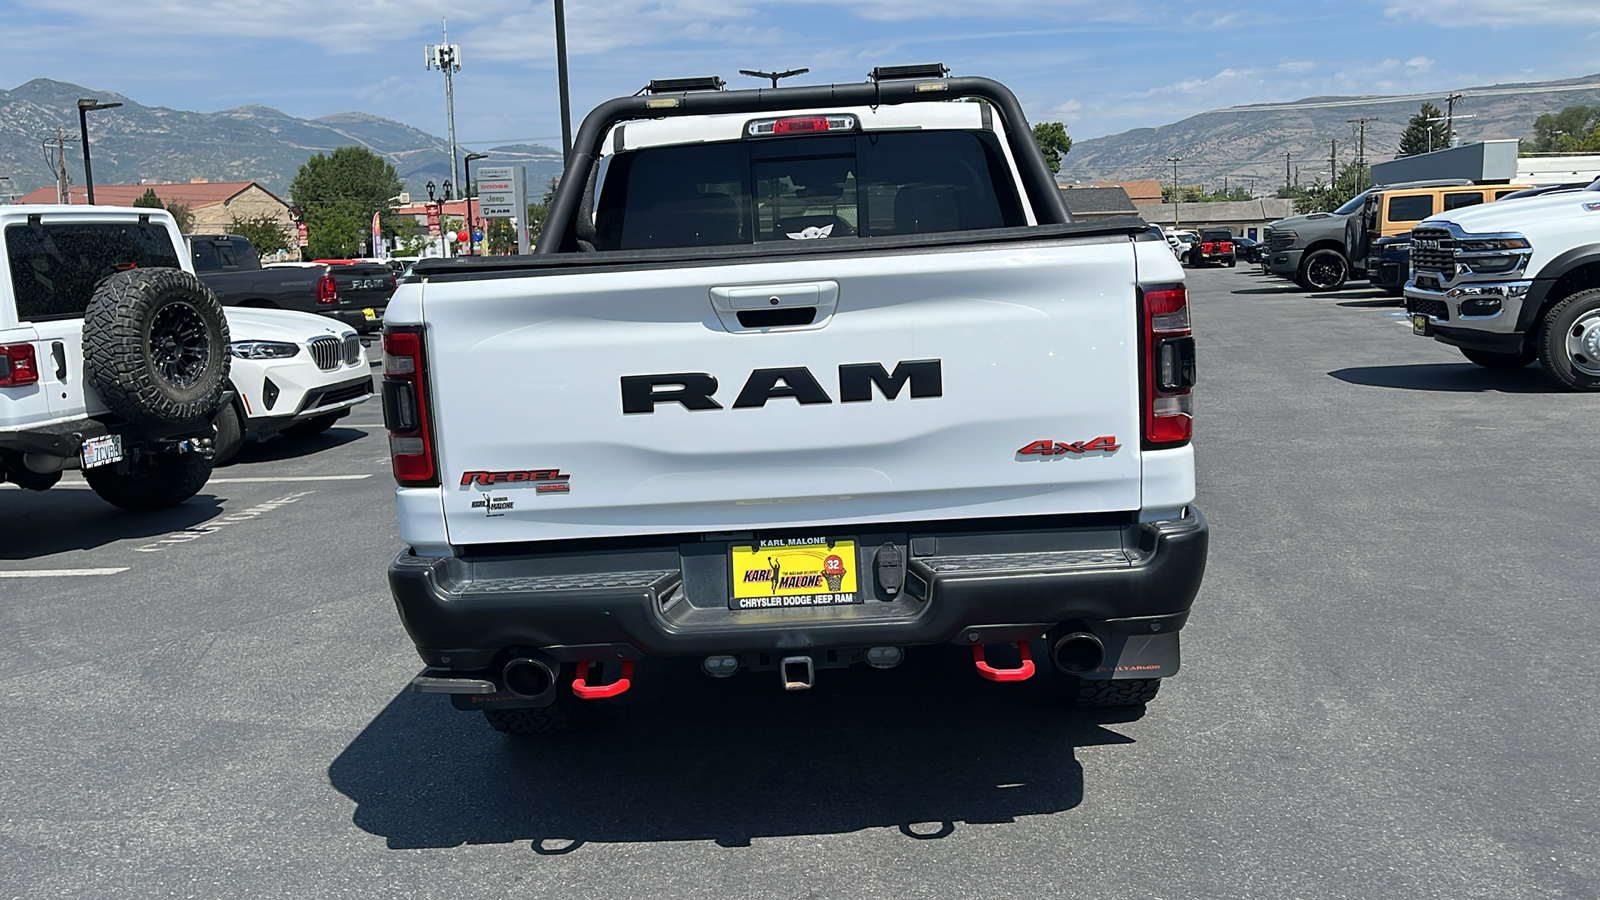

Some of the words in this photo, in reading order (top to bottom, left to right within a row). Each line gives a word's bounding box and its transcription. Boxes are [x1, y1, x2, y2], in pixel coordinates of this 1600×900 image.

[486, 195, 505, 203] Jeep
[352, 279, 384, 289] RAM
[620, 359, 943, 415] RAM
[1016, 435, 1121, 456] 4x4
[460, 469, 570, 486] REBEL
[491, 502, 514, 510] MALONE
[788, 537, 826, 546] MALONE
[827, 560, 840, 570] 32
[743, 569, 772, 583] KARL
[778, 575, 822, 589] MALONE
[740, 597, 783, 608] CHRYSLER
[783, 596, 812, 605] DODGE
[813, 594, 832, 604] JEEP
[834, 593, 853, 603] RAM
